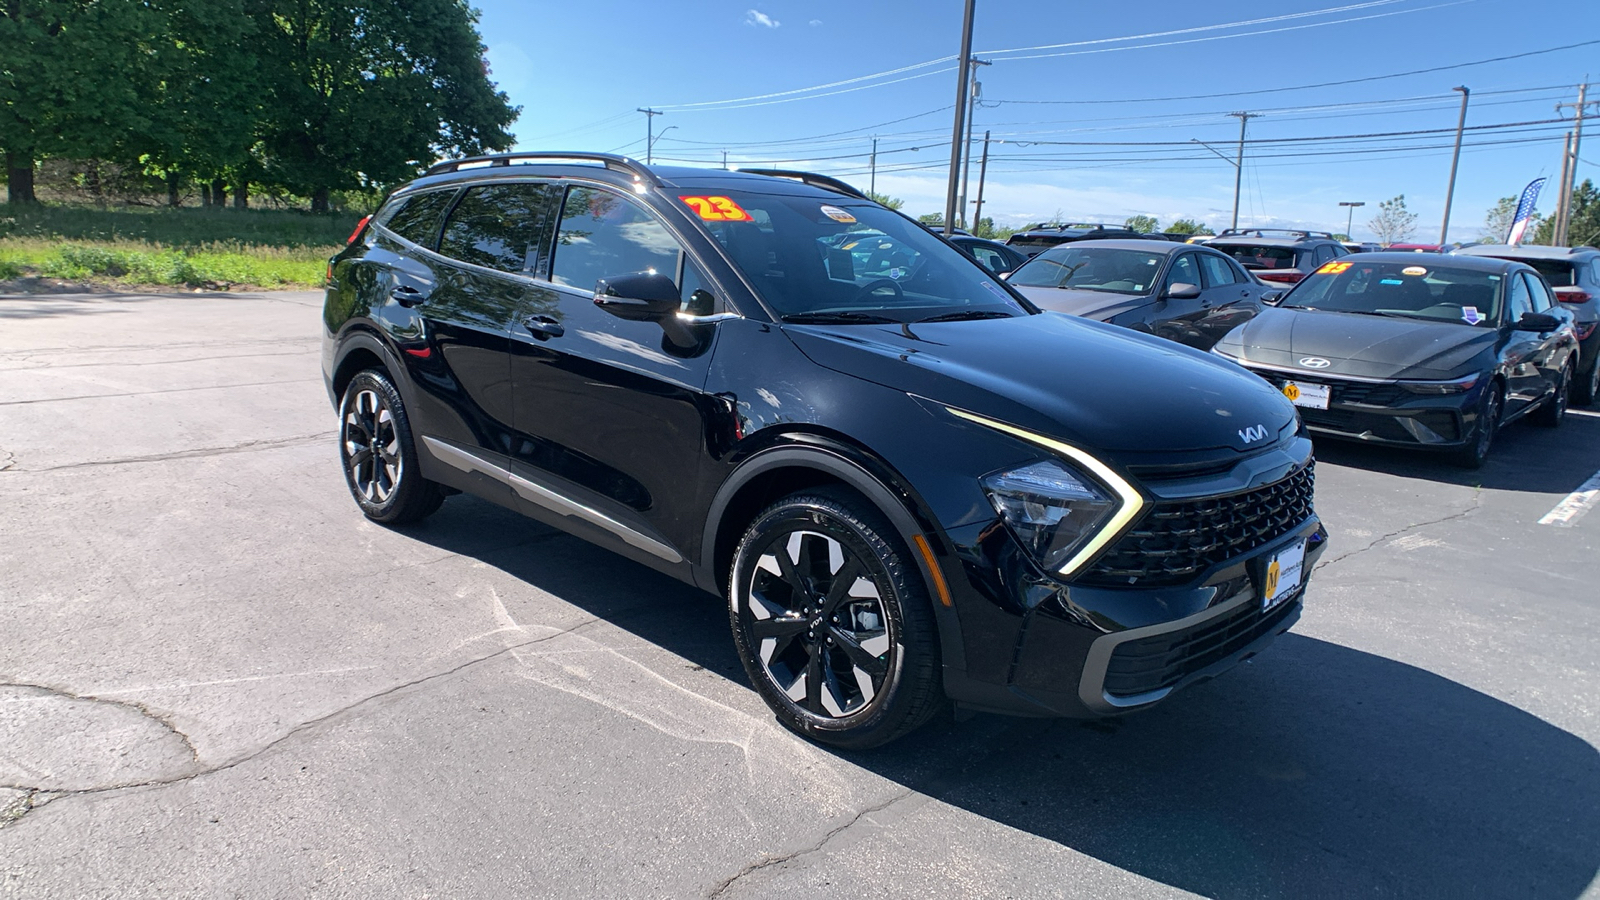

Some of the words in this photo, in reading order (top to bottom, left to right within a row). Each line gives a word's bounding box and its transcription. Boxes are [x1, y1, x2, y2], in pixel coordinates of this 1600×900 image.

[684, 196, 746, 220] 23
[1316, 262, 1348, 274] 25
[1286, 388, 1298, 398] M
[1266, 568, 1279, 592] M
